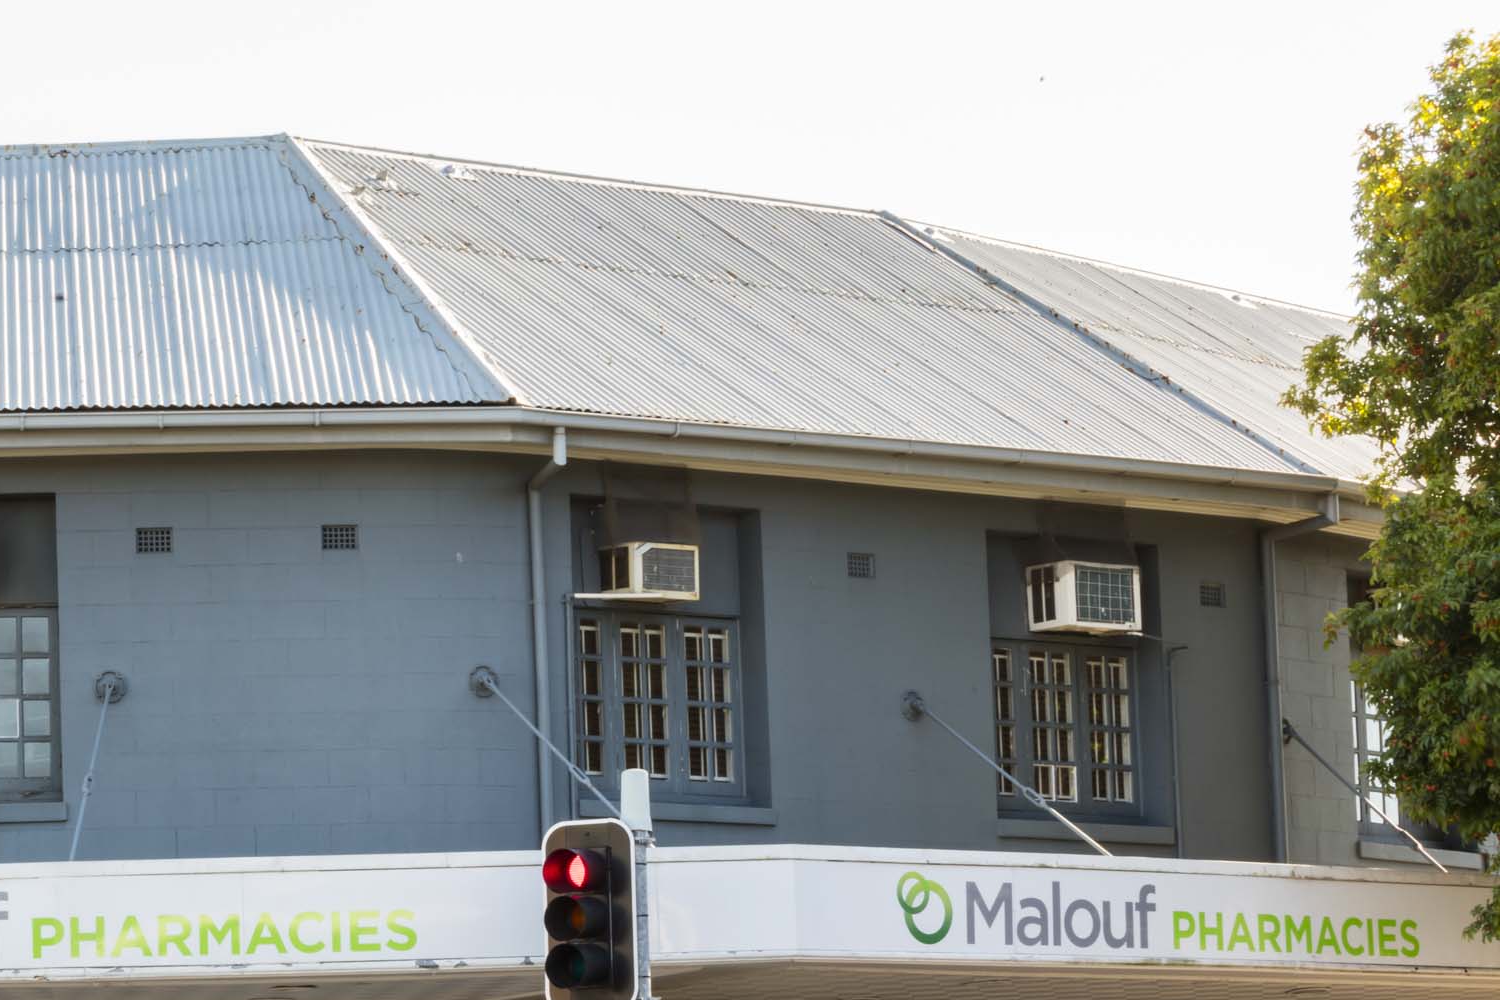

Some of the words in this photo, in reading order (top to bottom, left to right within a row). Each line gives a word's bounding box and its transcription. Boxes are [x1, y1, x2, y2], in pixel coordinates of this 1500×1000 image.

[32, 908, 419, 960] PHARMACIES
[965, 881, 1157, 950] Malouf
[1173, 910, 1421, 959] PHARMACIES
